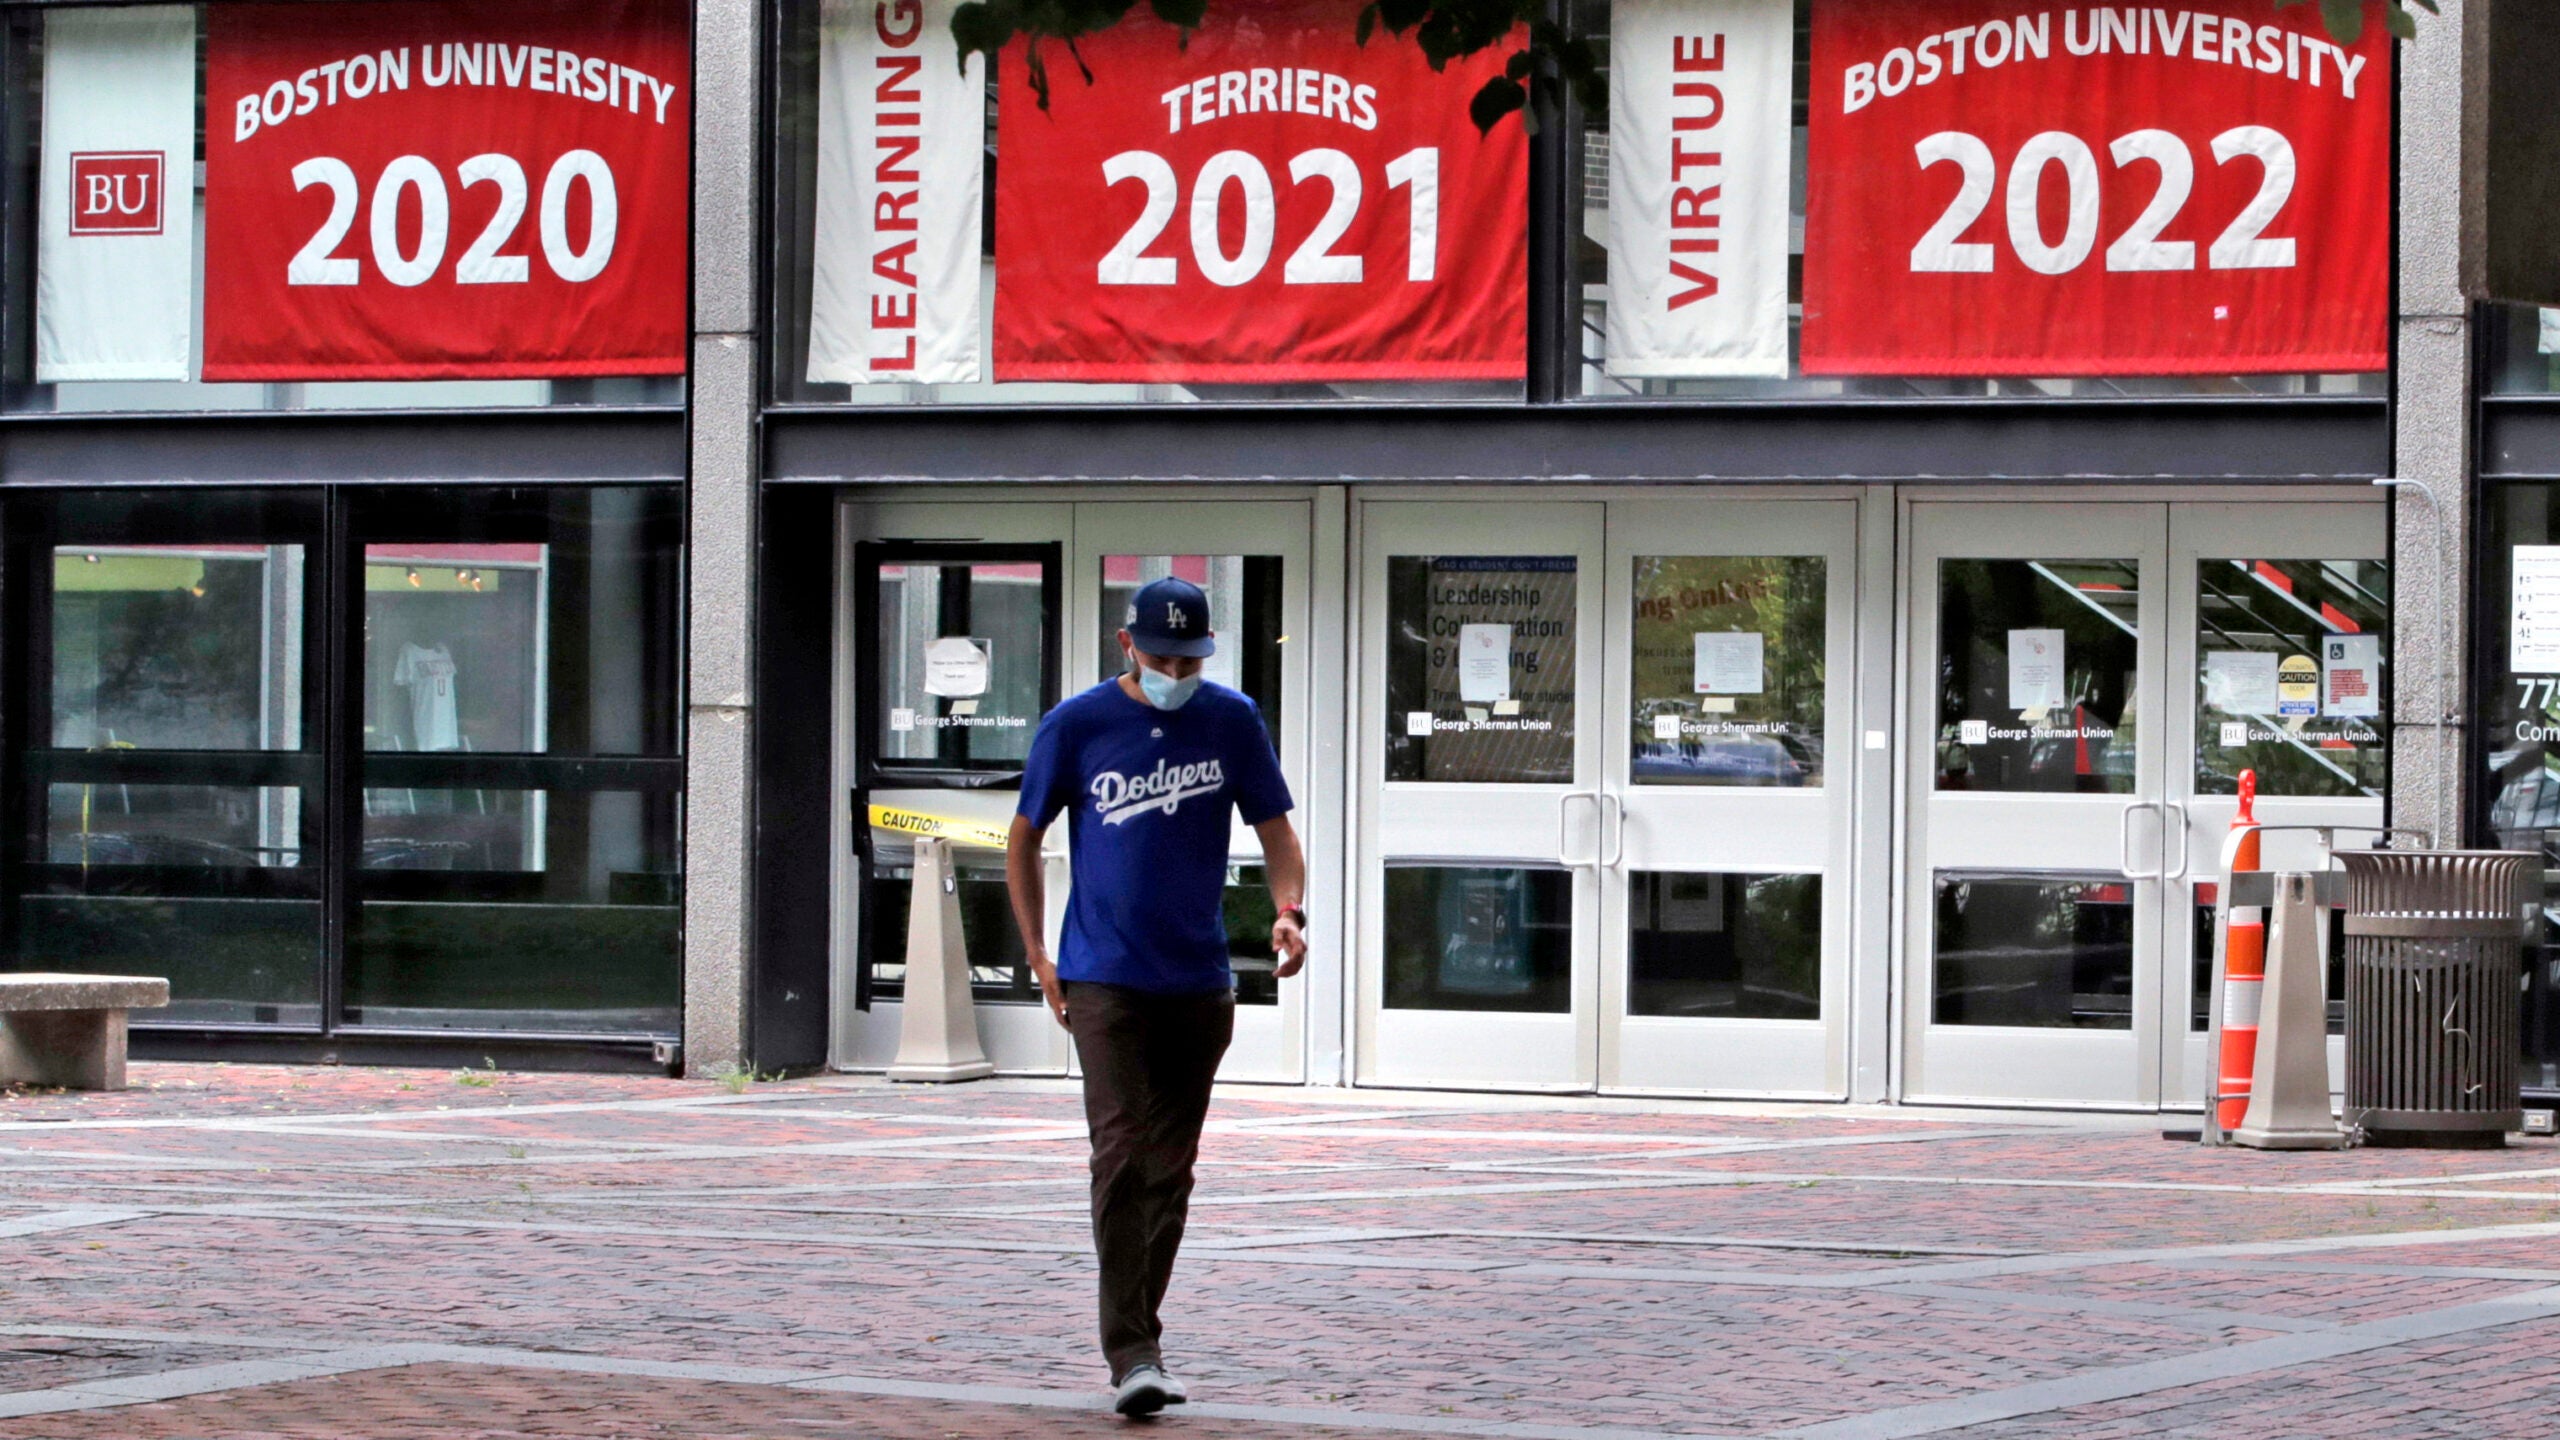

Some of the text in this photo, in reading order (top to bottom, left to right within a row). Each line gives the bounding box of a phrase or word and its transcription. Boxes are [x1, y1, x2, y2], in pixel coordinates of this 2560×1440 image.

[1843, 8, 2367, 115] BOSTON UNIVERSITY
[235, 43, 676, 143] BOSTON UNIVERSITY
[1160, 68, 1377, 134] TERRIERS
[869, 0, 922, 372] LEARNING
[1667, 34, 1725, 312] VIRTUE
[83, 173, 150, 215] BU
[1909, 125, 2297, 275] 2022
[287, 149, 618, 287] 2020
[1099, 147, 1439, 287] 2021
[1433, 583, 1541, 609] Leadership
[1166, 601, 1188, 629] LA
[1432, 647, 1447, 668] &
[2279, 673, 2316, 682] CAUTION
[2516, 678, 2560, 709] 77
[915, 715, 950, 728] George
[952, 714, 995, 727] Sherman
[997, 715, 1027, 727] Union
[1433, 718, 1470, 732] George
[1473, 718, 1518, 730] Sherman
[1521, 718, 1552, 730] Union
[1680, 721, 1719, 734] George
[1722, 721, 1768, 733] Sherman
[1988, 727, 2027, 741] George
[2031, 727, 2078, 738] Sherman
[2081, 727, 2114, 738] Union
[2224, 728, 2377, 743] BU George Sherman Union
[1091, 758, 1225, 827] Dodgers
[881, 812, 943, 833] CAUTION
